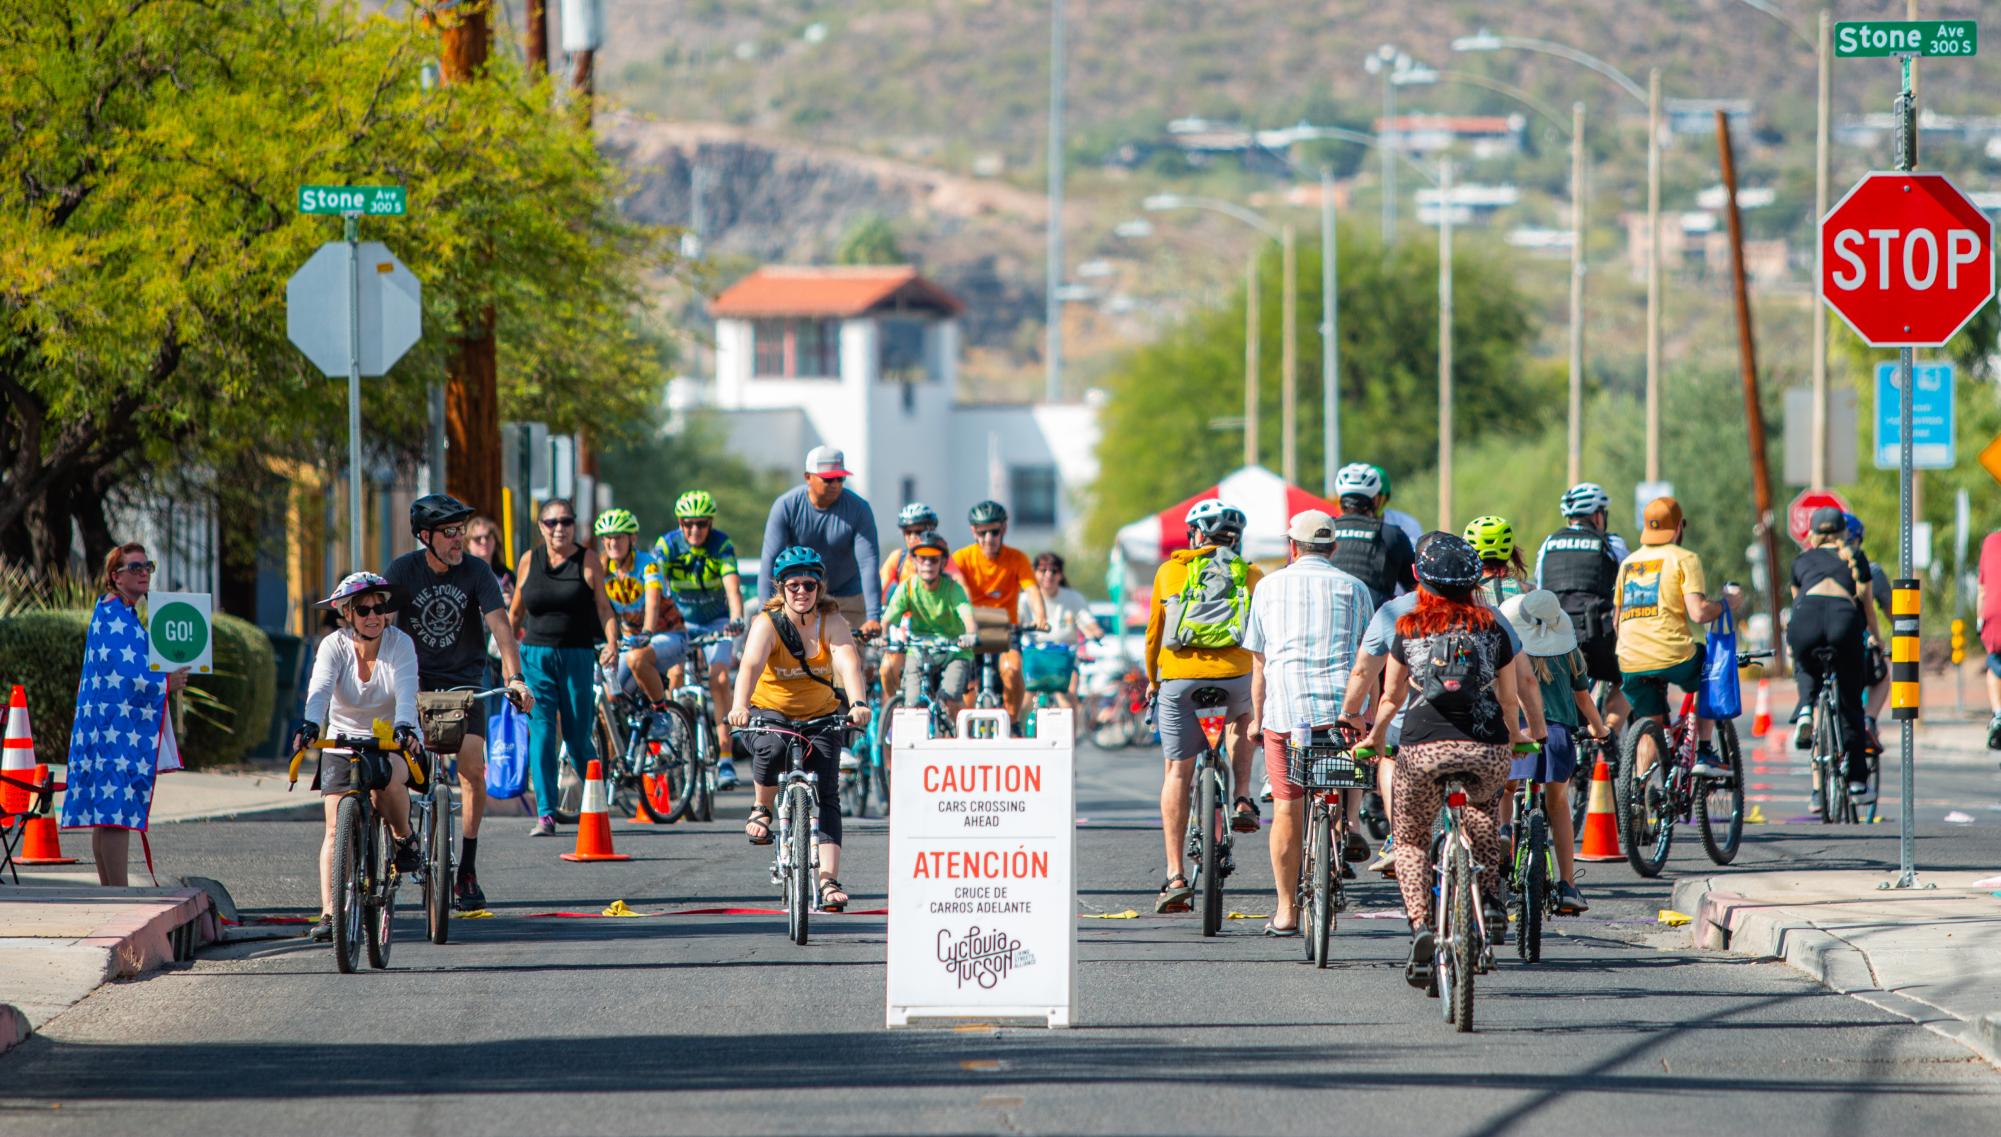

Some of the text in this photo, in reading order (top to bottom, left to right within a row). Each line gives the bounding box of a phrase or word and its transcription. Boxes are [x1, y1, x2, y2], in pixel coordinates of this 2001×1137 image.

[1936, 24, 1965, 38] Ave
[1839, 25, 1922, 53] Stone
[1929, 40, 1972, 54] 300 S
[302, 188, 365, 211] Stone
[376, 189, 397, 200] Ave
[370, 200, 402, 213] 300 S
[1832, 227, 1982, 291] STOP
[1547, 538, 1601, 550] POLICE
[411, 587, 432, 608] THE
[166, 620, 193, 641] GO!
[409, 617, 437, 648] NEVER
[439, 632, 456, 648] SAY
[923, 765, 1041, 793] CAUTION
[938, 801, 1026, 813] CARS CROSSING
[963, 816, 1000, 827] AHEAD
[913, 845, 1048, 879] ATENCIÓN
[954, 887, 1008, 899] CRUCE DE
[930, 902, 1032, 914] CARROS ADELANTE
